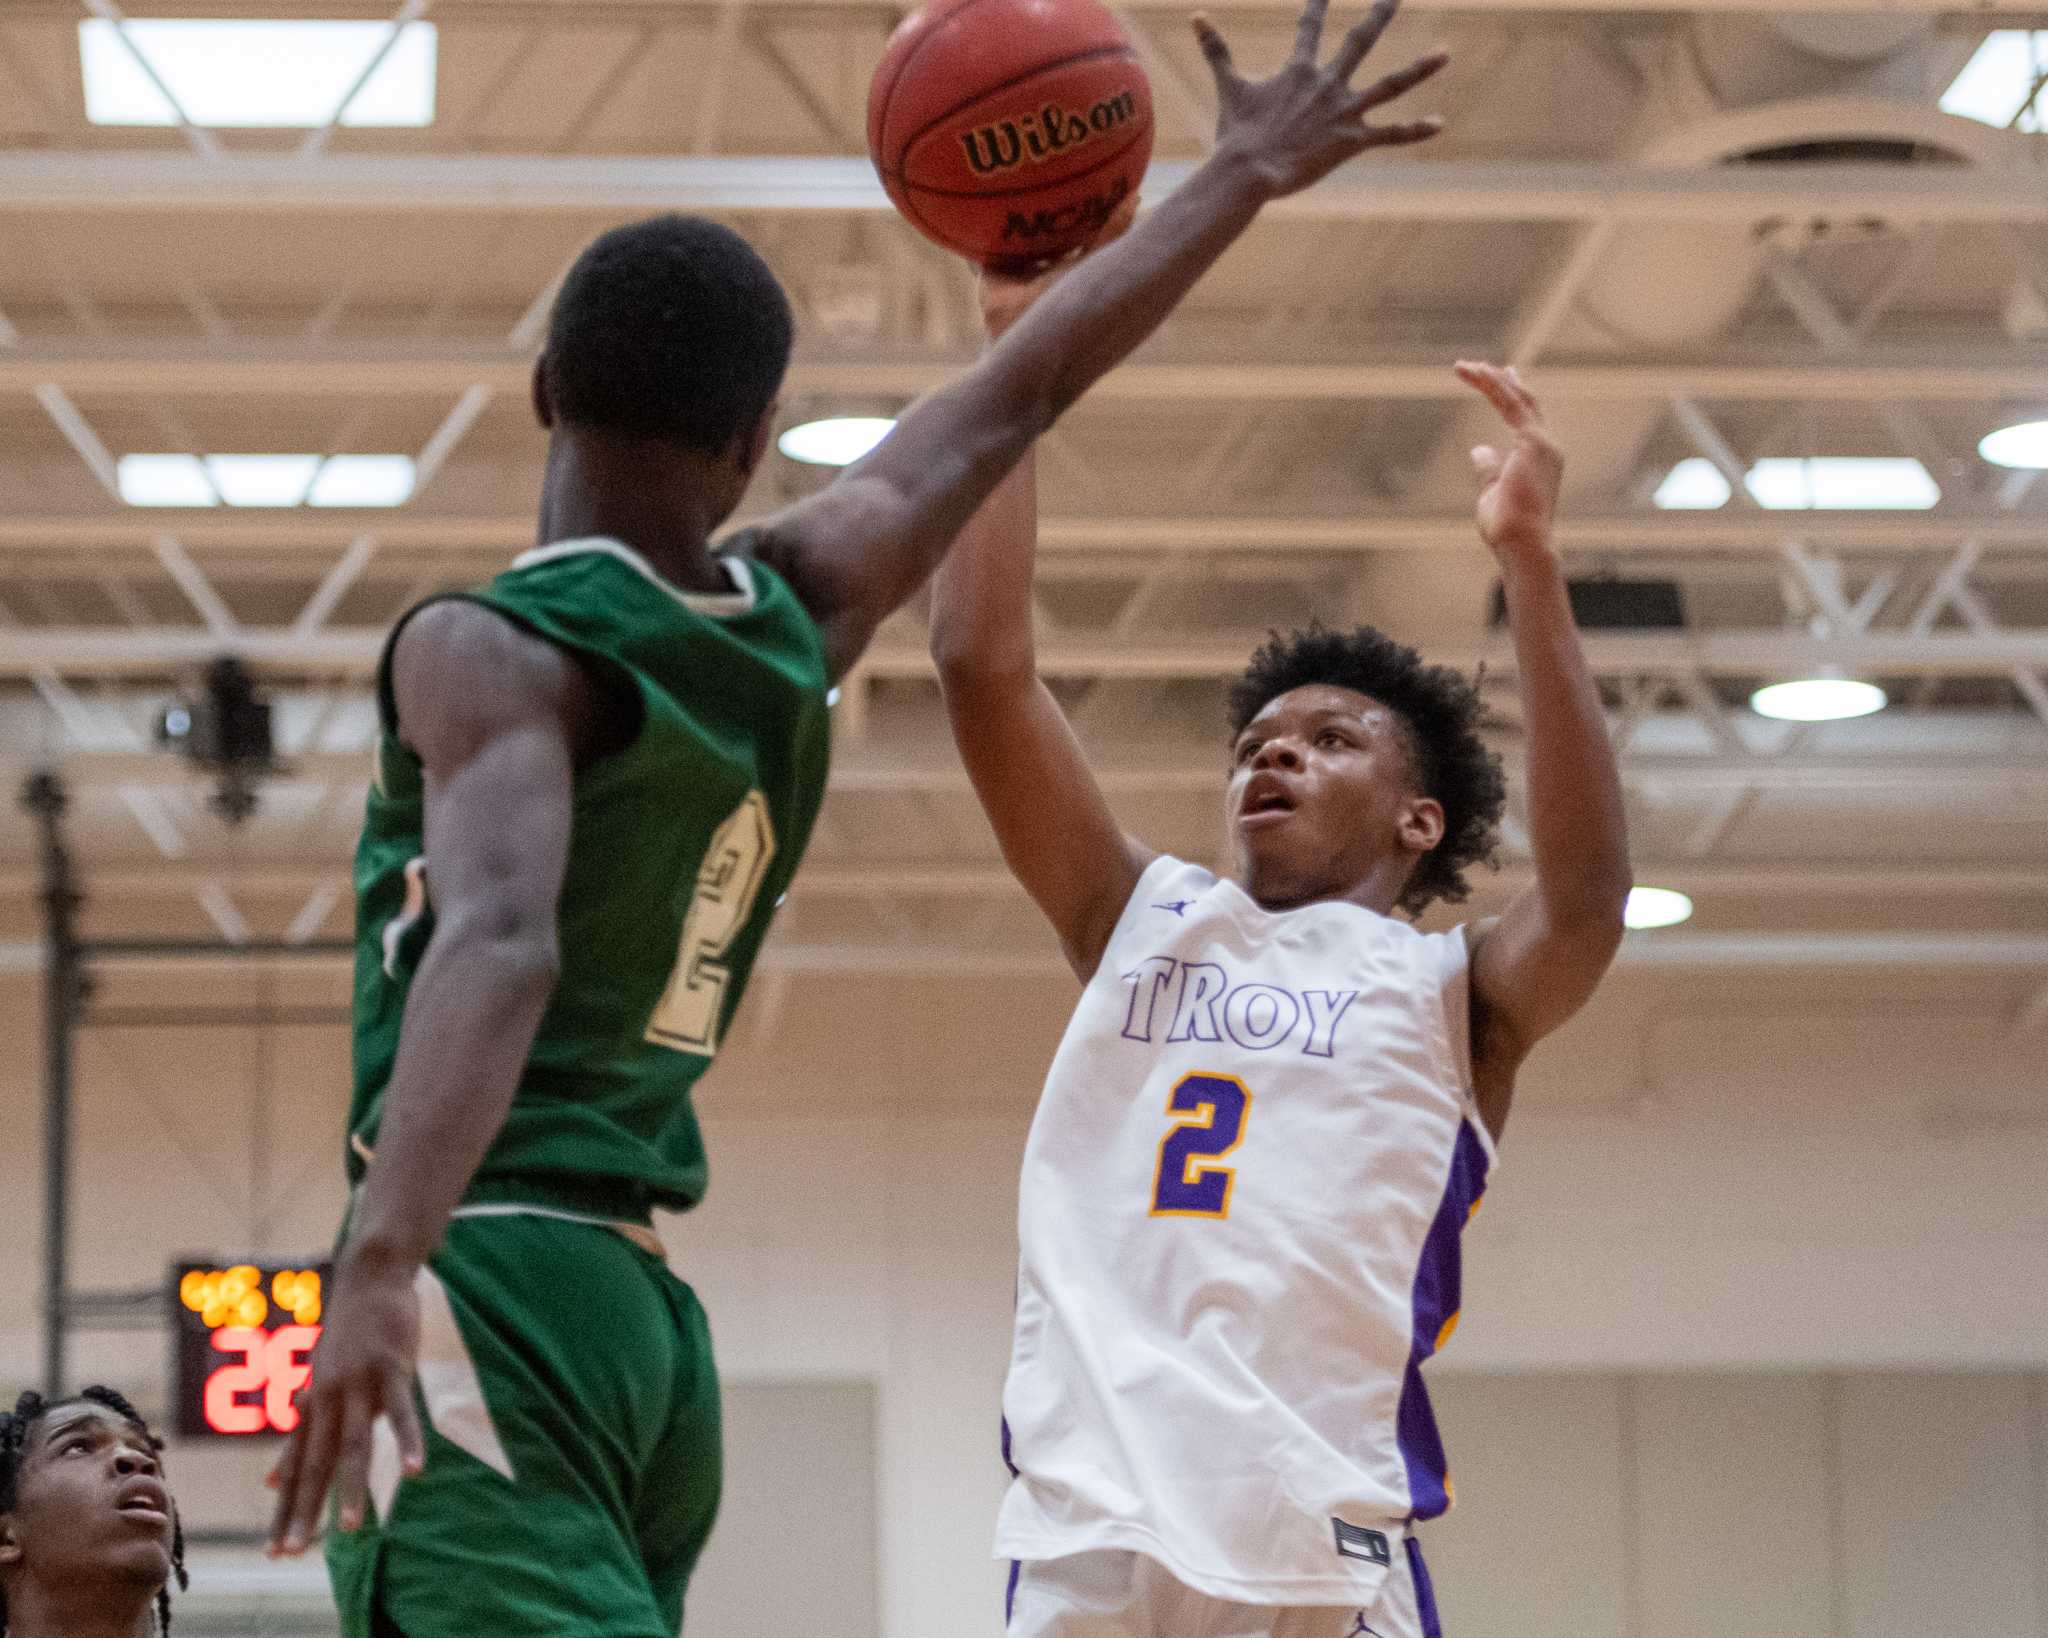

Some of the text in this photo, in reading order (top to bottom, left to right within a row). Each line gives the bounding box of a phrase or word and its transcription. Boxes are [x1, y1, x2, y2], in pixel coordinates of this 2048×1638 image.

[961, 90, 1137, 175] Wilson
[643, 788, 777, 1057] 2
[1121, 956, 1360, 1058] TROY
[1149, 1070, 1253, 1220] 2
